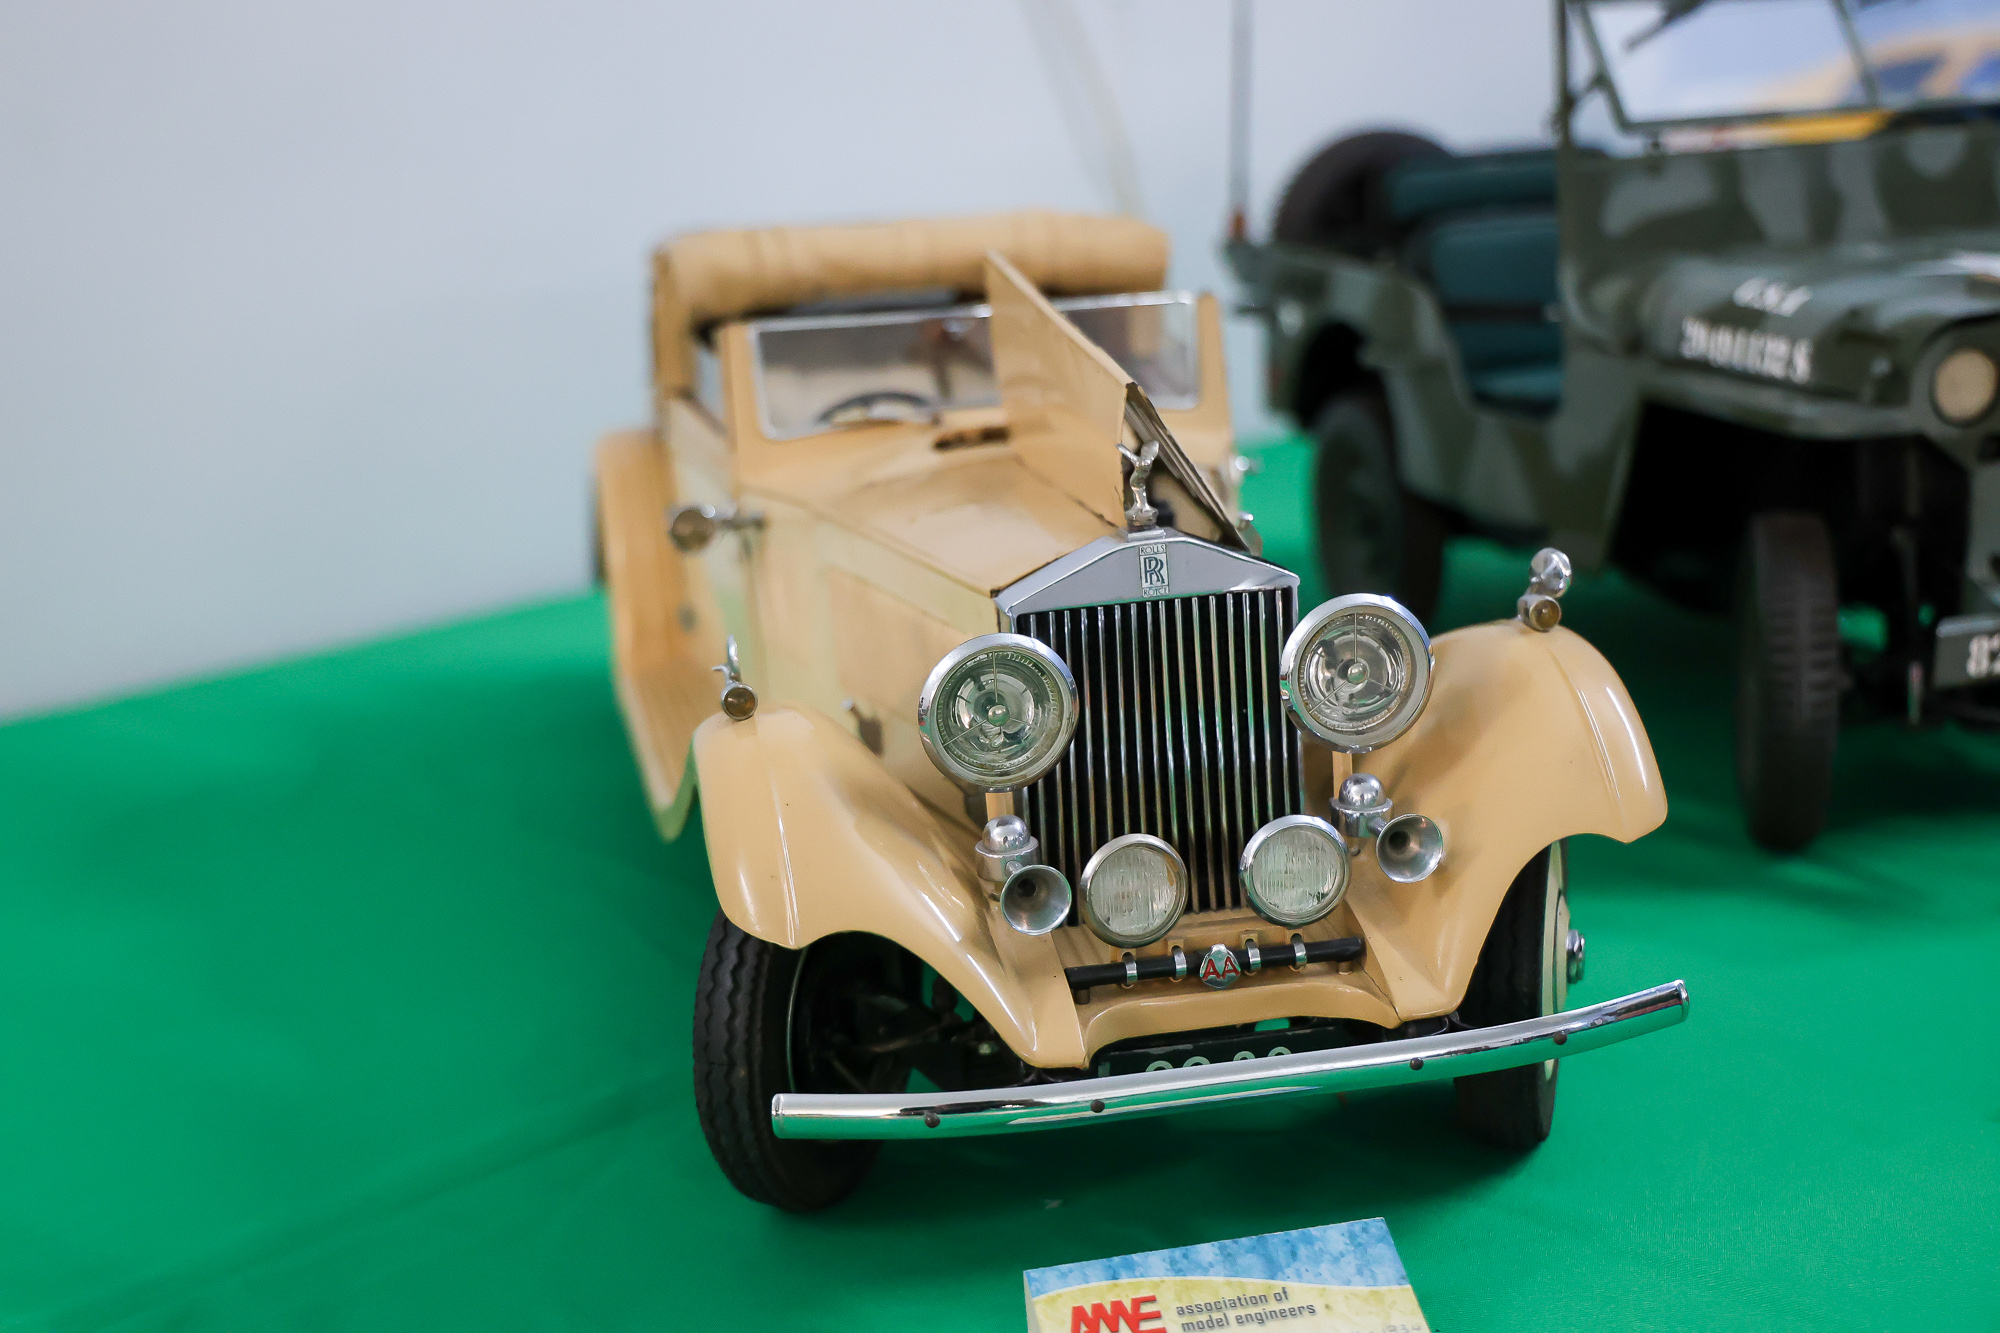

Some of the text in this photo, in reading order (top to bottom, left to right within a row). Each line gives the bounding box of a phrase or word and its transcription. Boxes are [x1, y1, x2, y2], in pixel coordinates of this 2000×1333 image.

[1141, 545, 1165, 555] ROLLS
[1202, 956, 1240, 980] AA
[1176, 1287, 1289, 1316] association of
[1182, 1304, 1316, 1332] model engineers
